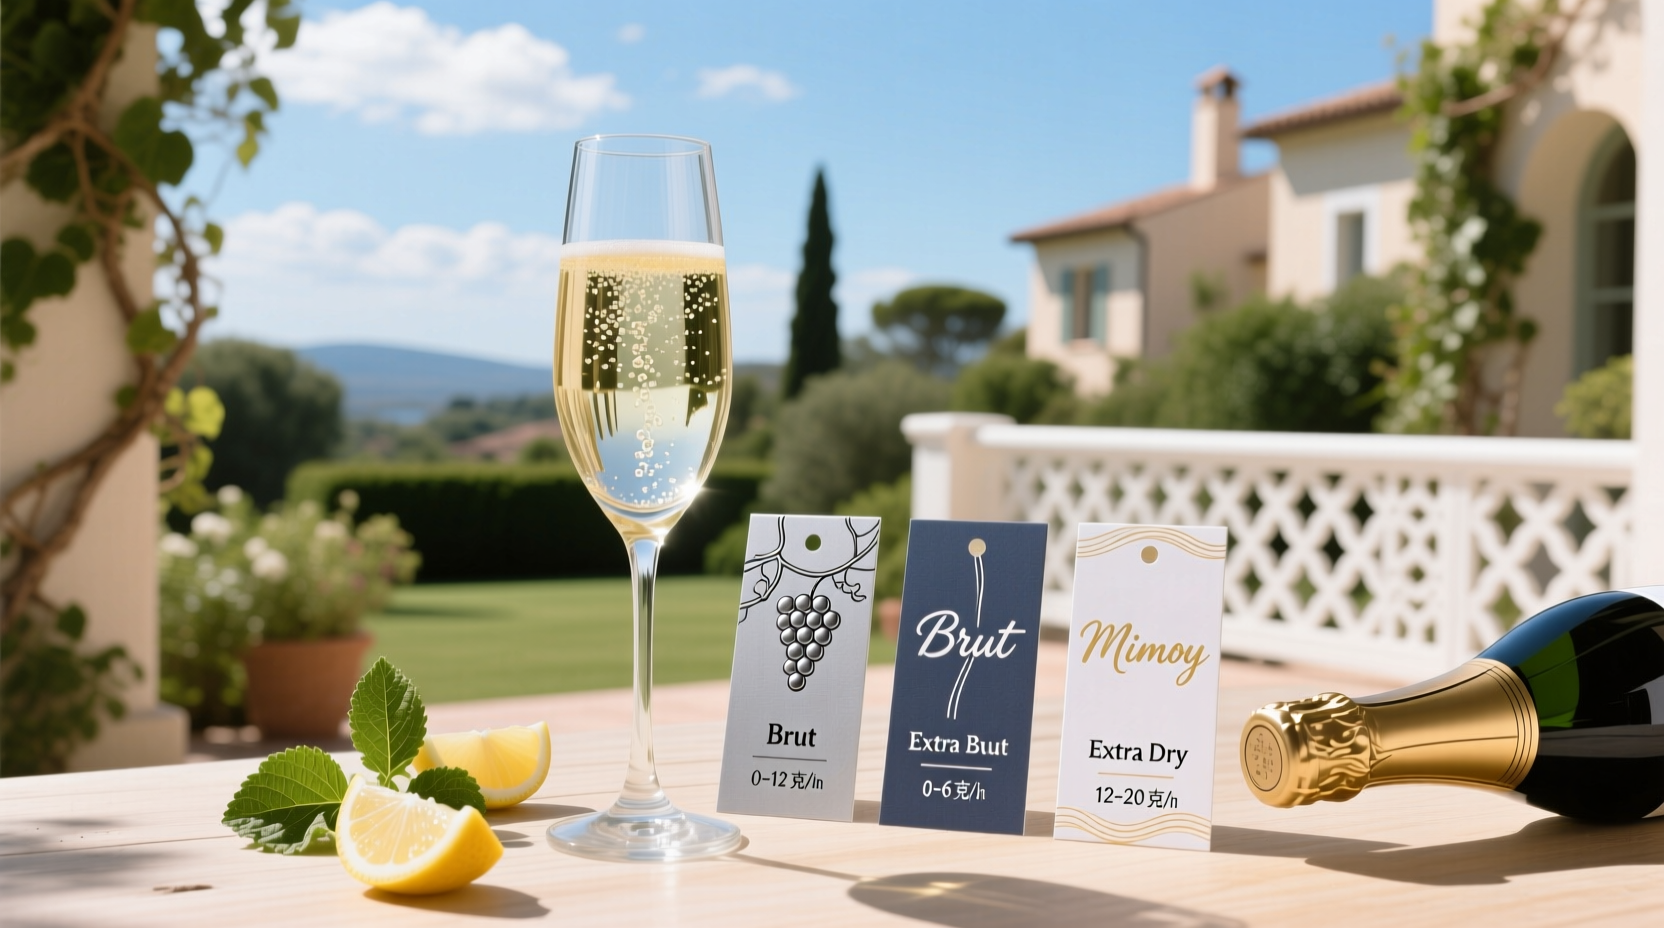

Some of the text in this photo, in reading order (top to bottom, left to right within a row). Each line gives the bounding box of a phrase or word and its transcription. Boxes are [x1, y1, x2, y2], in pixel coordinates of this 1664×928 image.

[916, 610, 1026, 659] Brut
[1080, 619, 1211, 687] Mimoy
[766, 722, 817, 748] Brut
[908, 731, 960, 754] Extra
[1088, 739, 1189, 770] Extra Dry
